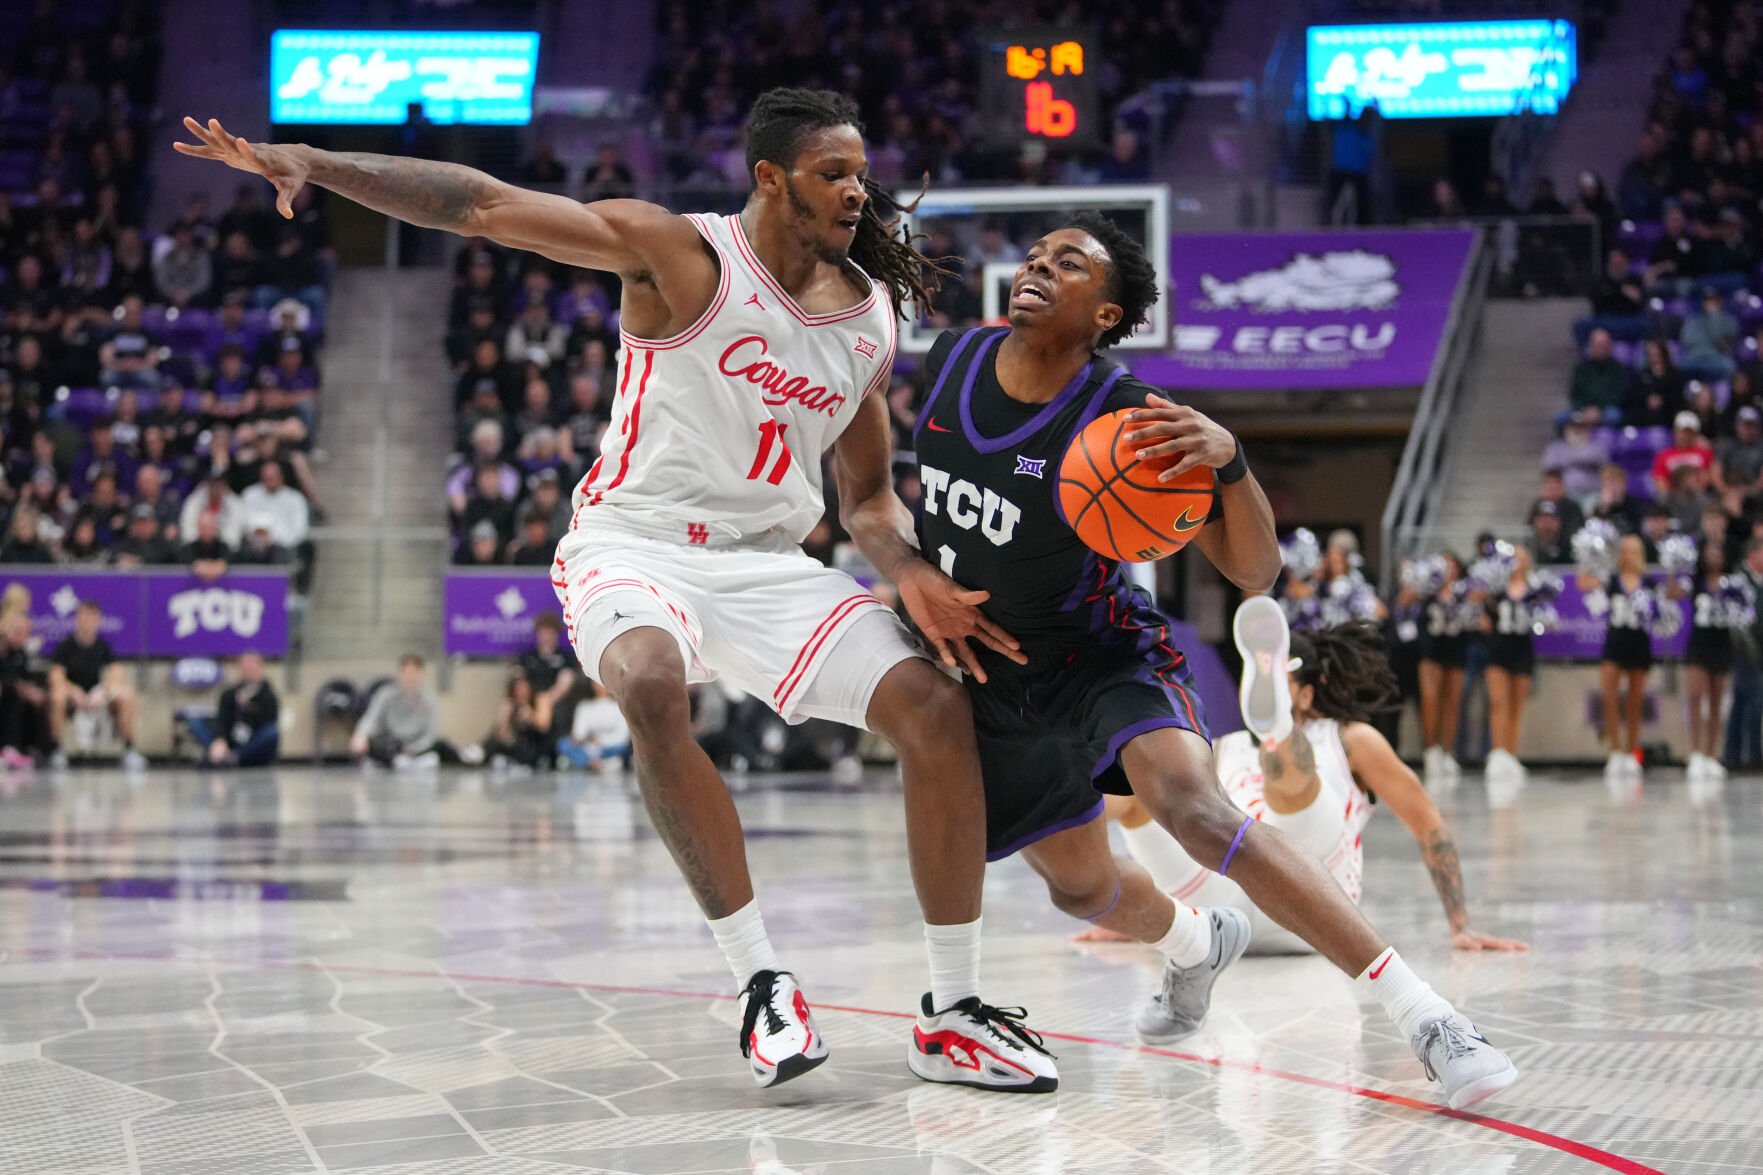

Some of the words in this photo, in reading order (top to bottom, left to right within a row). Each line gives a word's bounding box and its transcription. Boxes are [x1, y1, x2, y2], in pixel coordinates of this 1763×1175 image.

[1025, 81, 1076, 137] 16
[1233, 322, 1396, 352] EECU
[747, 418, 791, 485] 11
[921, 464, 1022, 546] TCU
[168, 587, 264, 638] TCU
